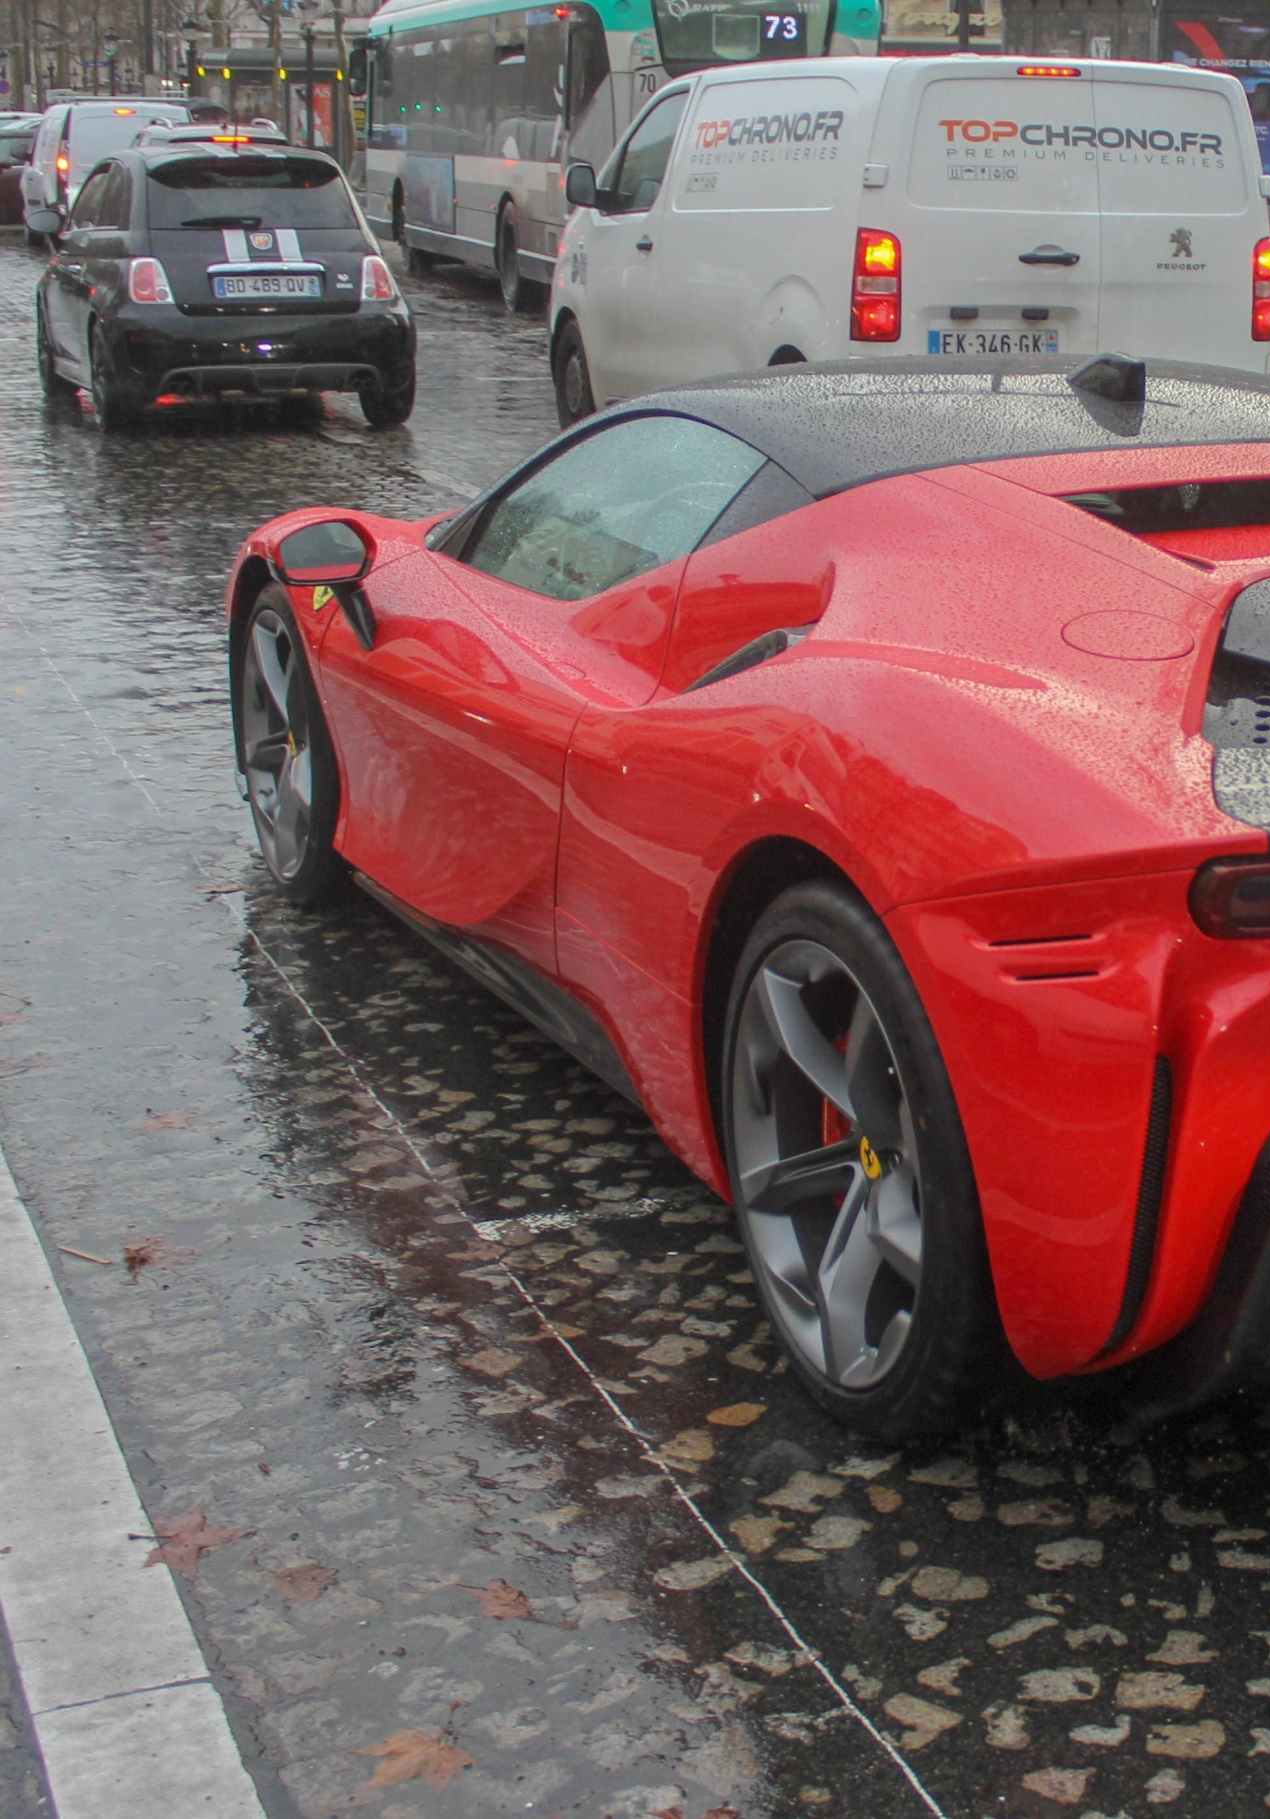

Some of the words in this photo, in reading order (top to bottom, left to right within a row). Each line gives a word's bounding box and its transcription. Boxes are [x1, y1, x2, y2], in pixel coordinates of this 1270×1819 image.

[765, 15, 798, 39] 73
[640, 73, 657, 94] 70
[695, 110, 844, 149] TOPCHRONO.FR
[938, 119, 1223, 155] TOPCHRONO.FR
[690, 151, 746, 166] PREMIUM
[751, 147, 838, 162] DELIVERIES
[946, 148, 1067, 161] PREMIUM
[1085, 151, 1226, 169] DELIVERIES
[1156, 262, 1207, 271] PEUGEOT
